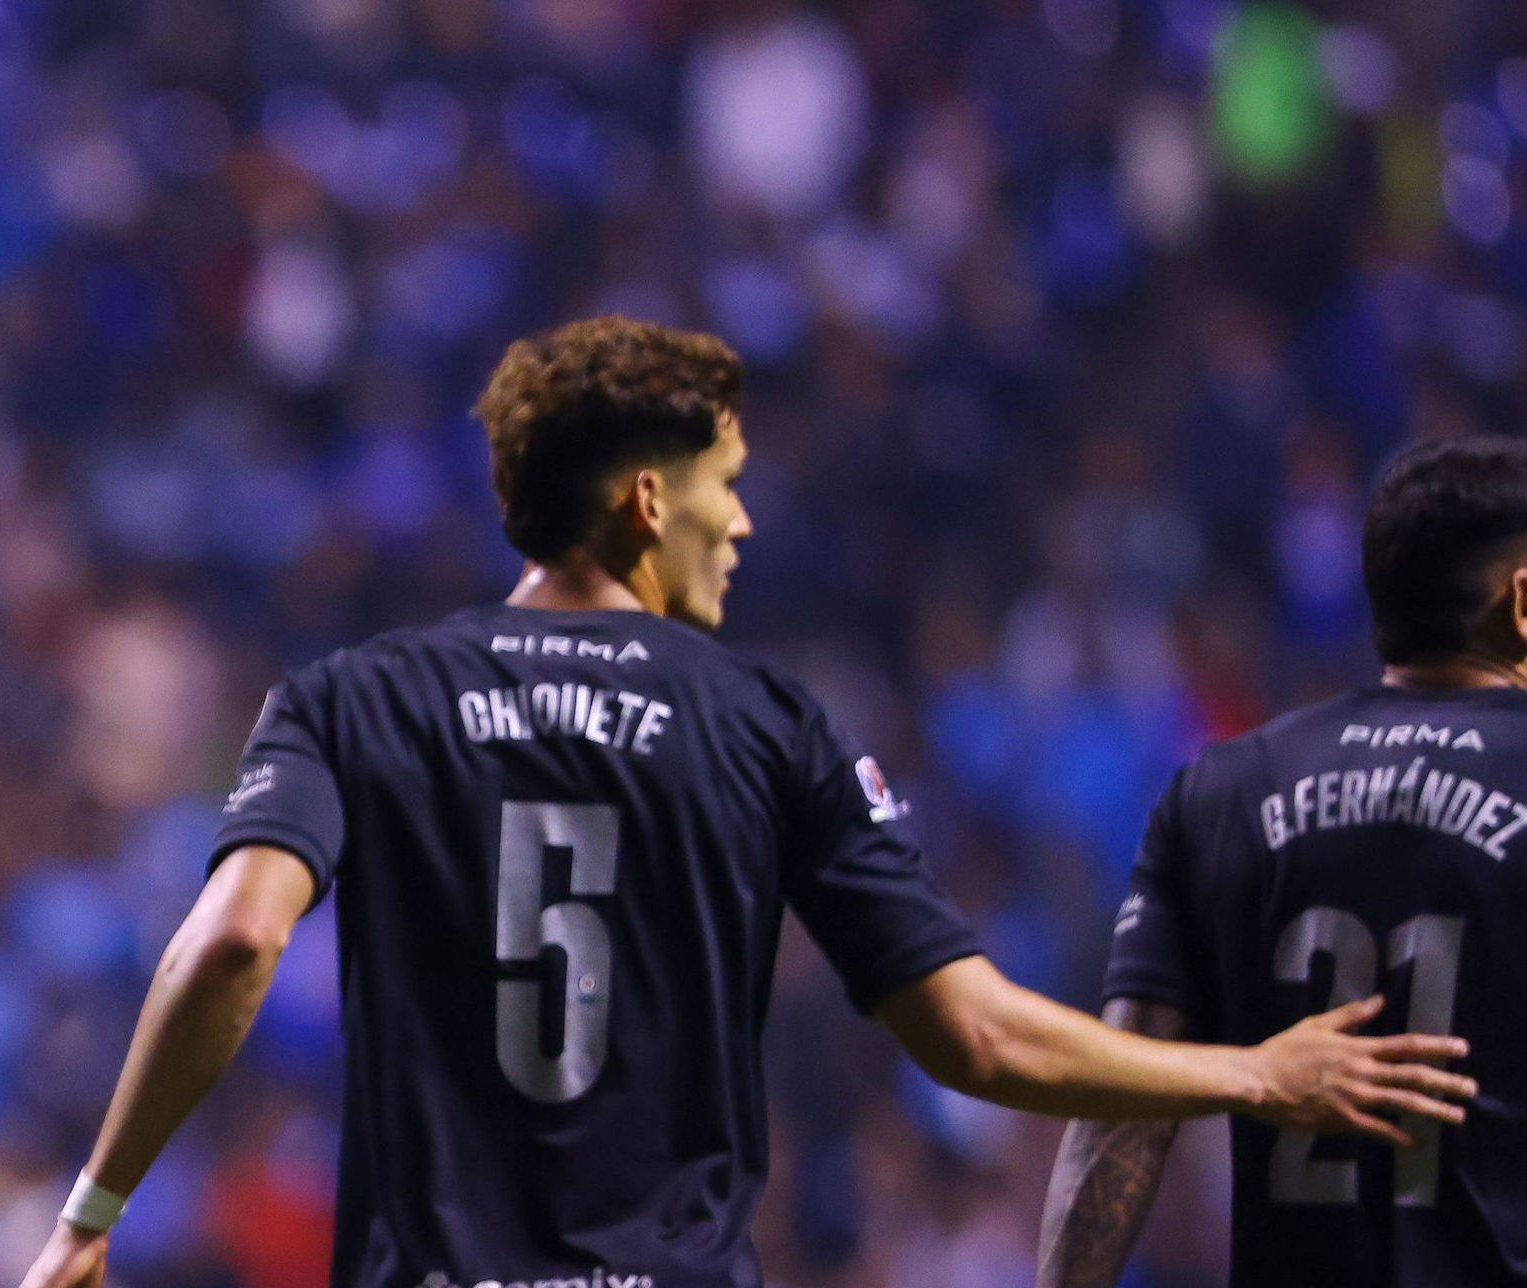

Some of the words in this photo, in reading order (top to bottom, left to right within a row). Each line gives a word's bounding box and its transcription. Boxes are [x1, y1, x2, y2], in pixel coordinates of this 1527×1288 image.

[490, 634, 650, 664] PIRMA
[1340, 724, 1485, 751] PIRMA
[496, 801, 619, 1104] 5
[1269, 905, 1466, 1209] 21
